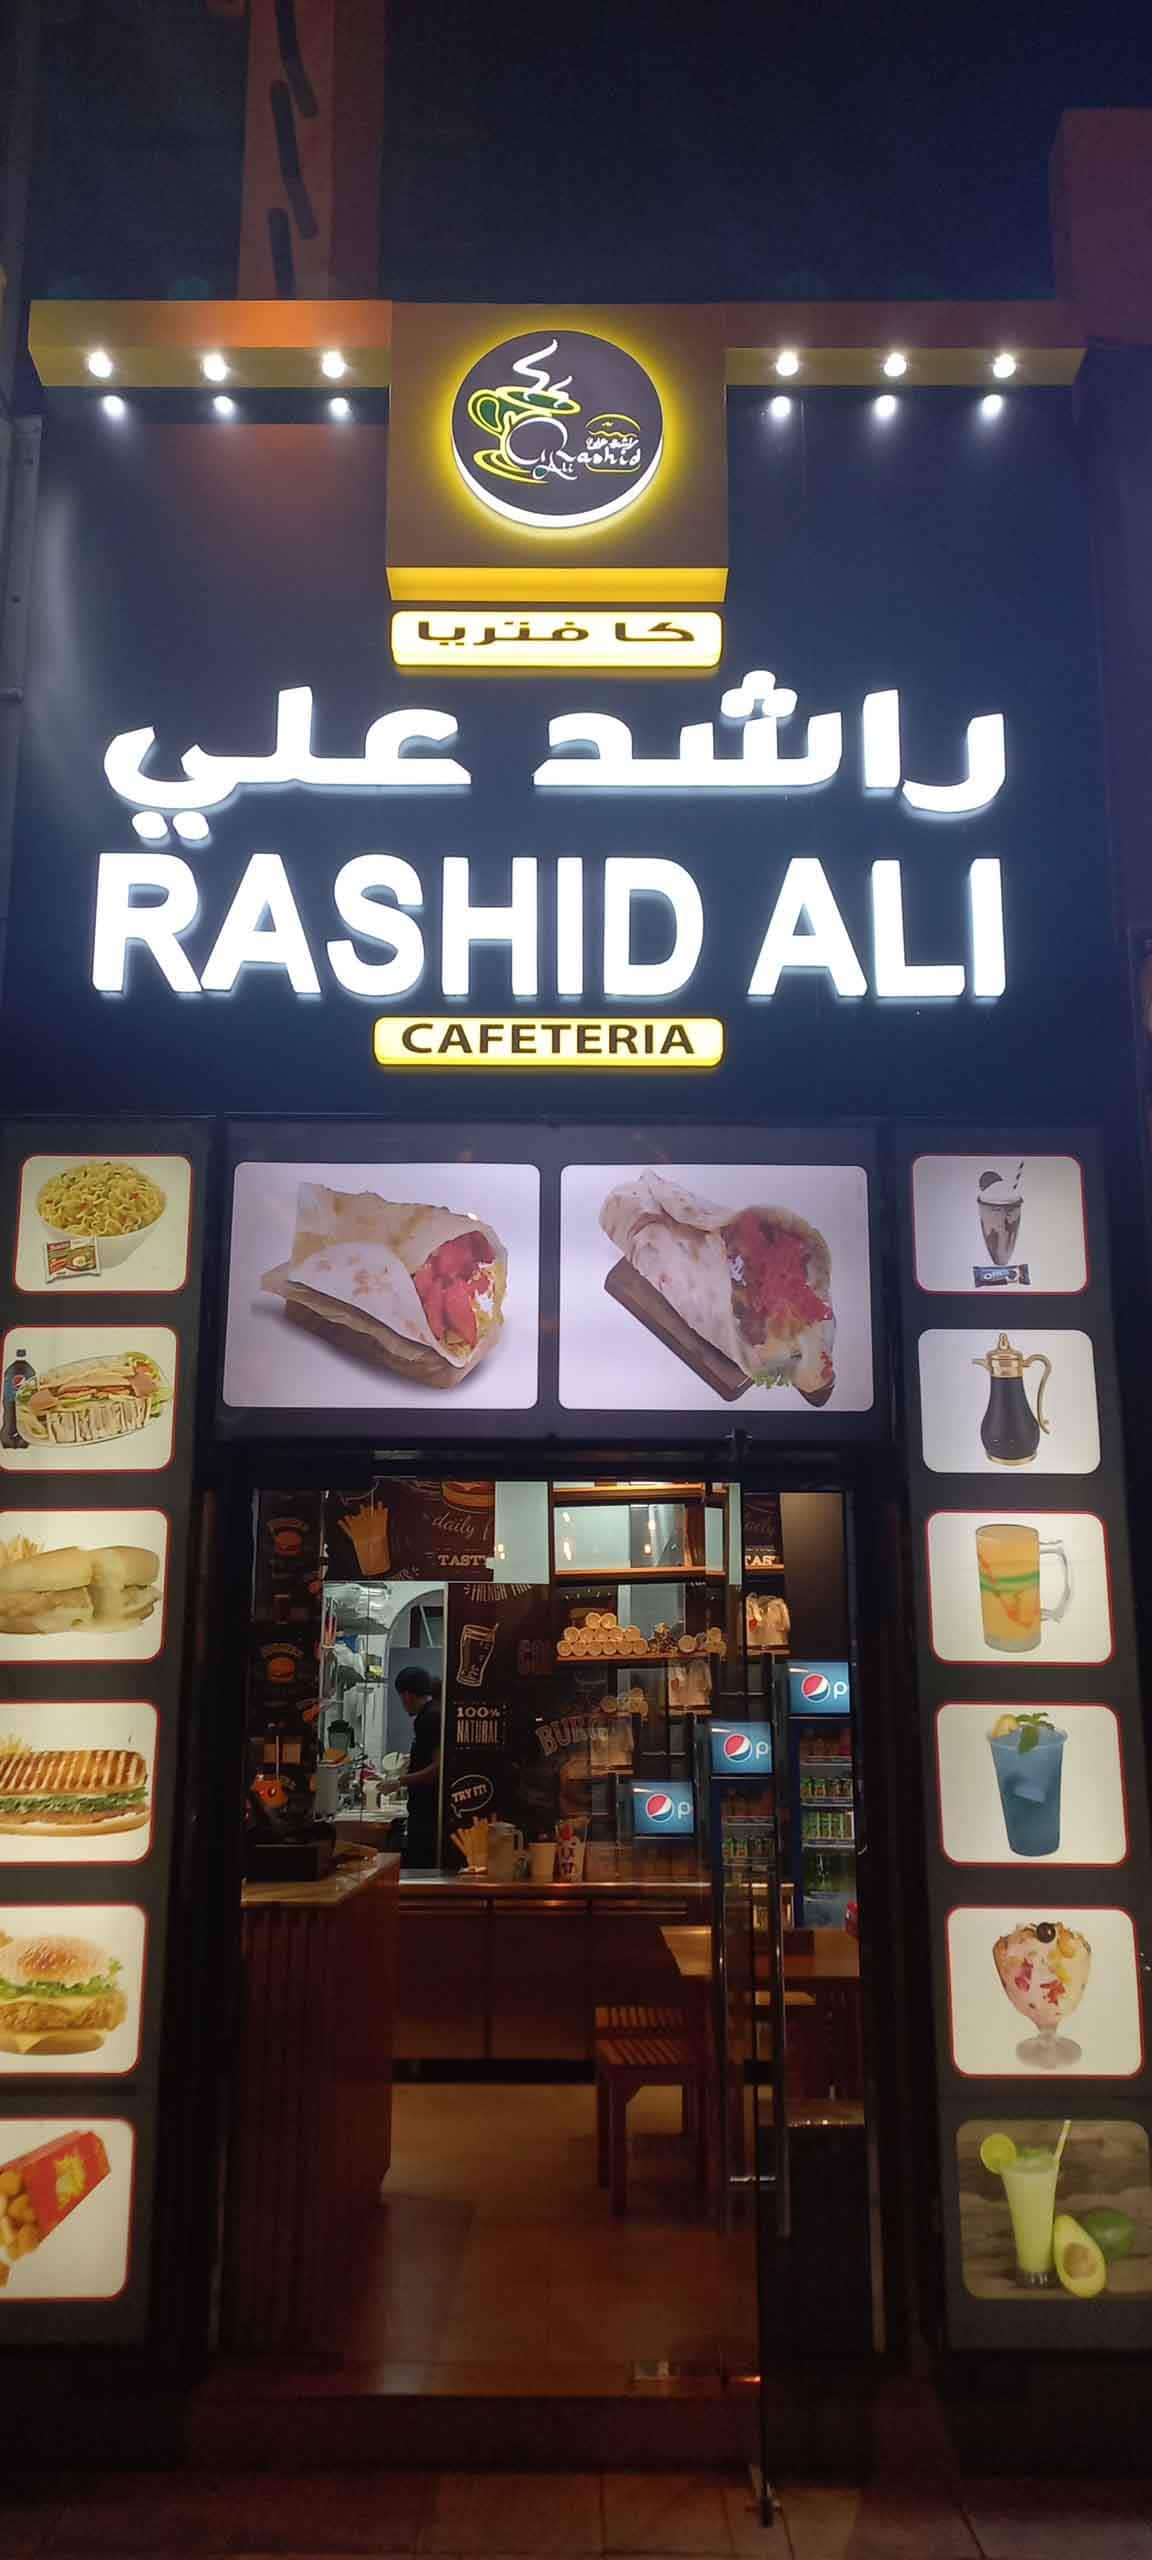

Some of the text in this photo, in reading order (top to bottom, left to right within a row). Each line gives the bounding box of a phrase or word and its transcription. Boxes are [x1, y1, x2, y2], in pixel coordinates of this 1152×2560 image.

[104, 670, 1007, 841] راشد علي
[91, 852, 1007, 999] RASHID ALI
[400, 1022, 697, 1055] CAFETERIA
[456, 1706, 501, 1719] 100%
[456, 1719, 499, 1745] NATURAL
